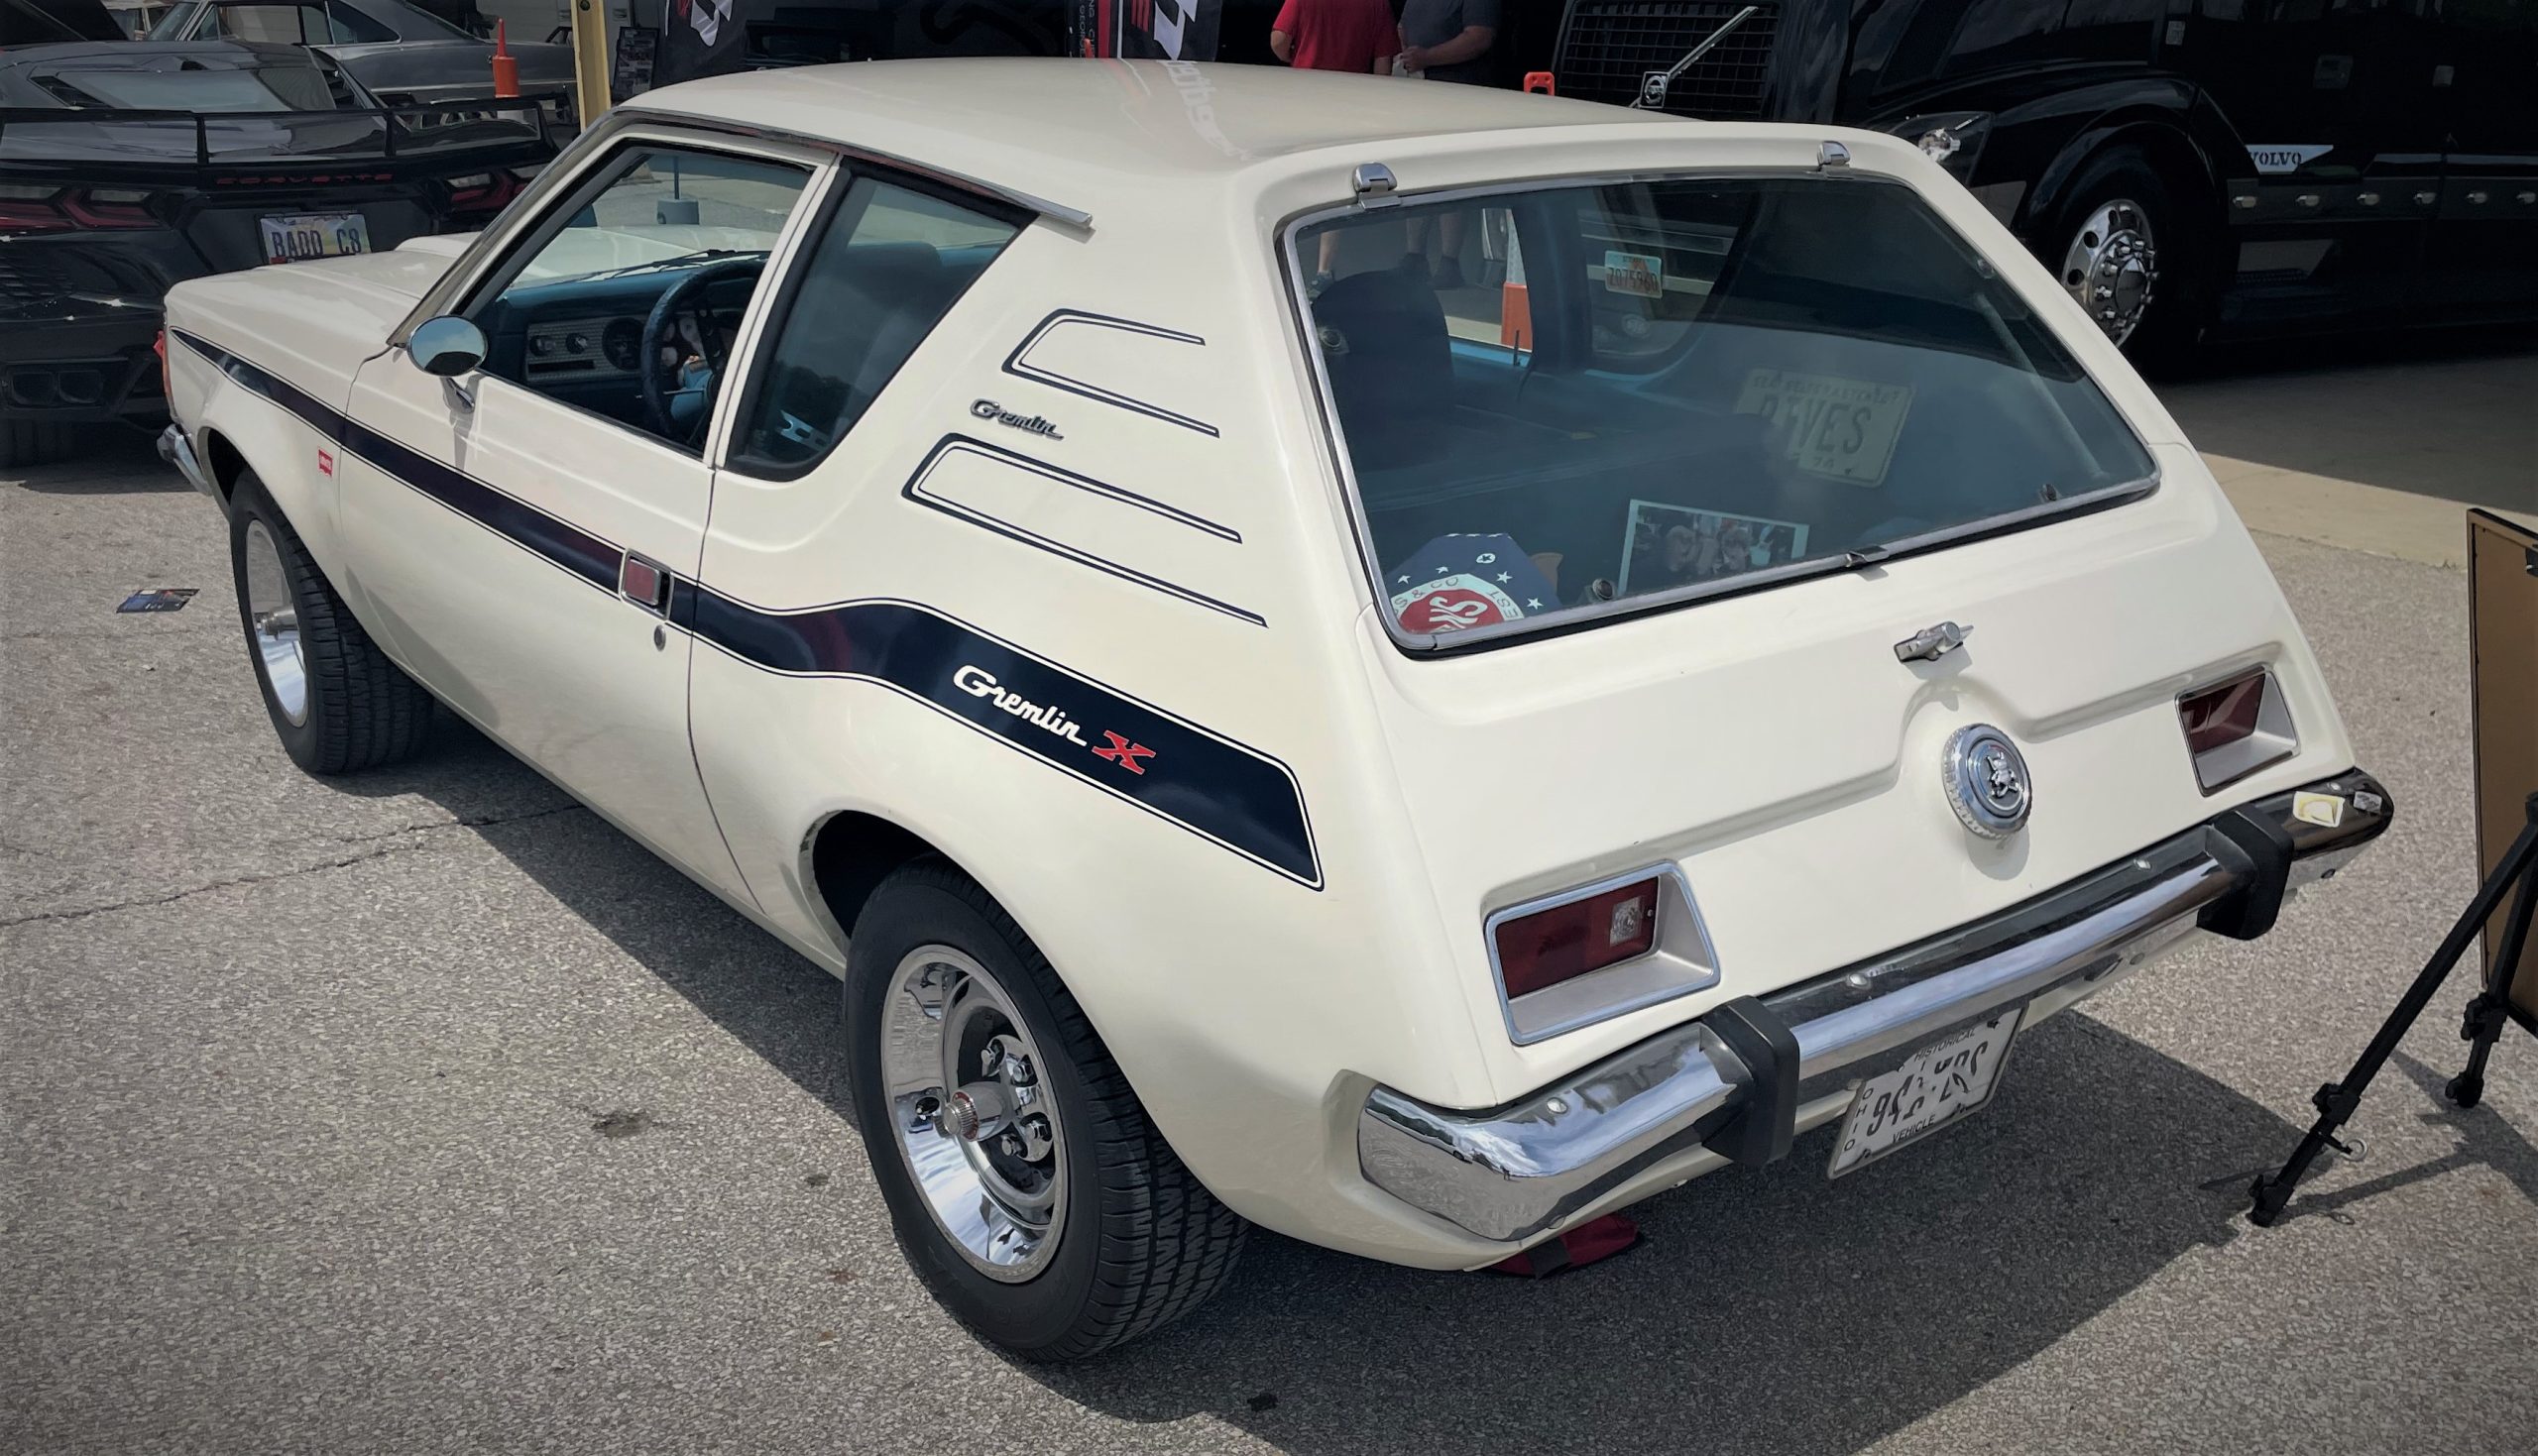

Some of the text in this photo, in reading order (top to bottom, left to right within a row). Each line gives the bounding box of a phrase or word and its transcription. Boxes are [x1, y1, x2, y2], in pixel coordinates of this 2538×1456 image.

[2249, 151, 2302, 167] VOLVO
[216, 173, 393, 185] CORVETTE
[336, 227, 362, 254] C8
[970, 398, 1065, 441] Gremlin
[953, 665, 1156, 775] Gremlin X
[1913, 1029, 1976, 1063] HISTORICAL
[1843, 1087, 1874, 1152] OHIO
[1893, 1114, 1936, 1144] VEHICLE
